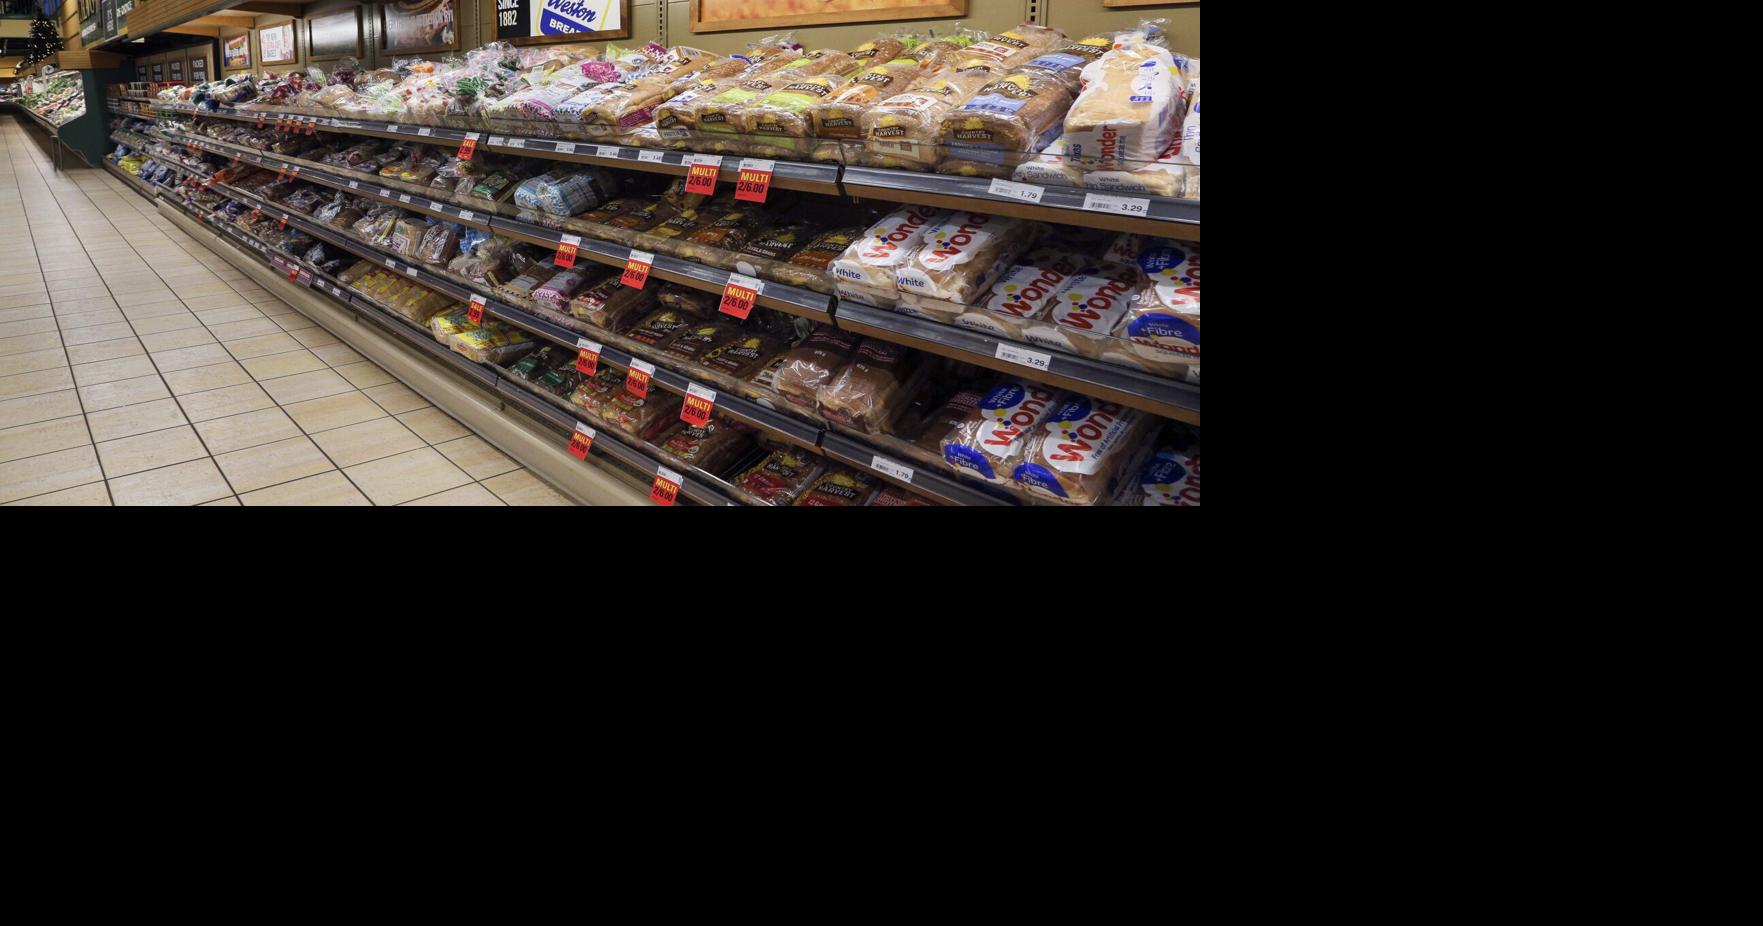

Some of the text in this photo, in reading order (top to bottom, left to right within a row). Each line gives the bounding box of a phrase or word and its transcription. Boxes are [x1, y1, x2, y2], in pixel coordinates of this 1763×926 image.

[498, 0, 519, 10] SINCE
[547, 0, 597, 22] Weston
[499, 10, 517, 27] 1882
[691, 167, 717, 177] MULTI
[740, 171, 769, 183] MULTI
[688, 177, 712, 187] 2/6.00
[738, 182, 764, 193] 2/6.00
[1020, 190, 1038, 199] 1.79
[1121, 203, 1143, 213] 3.29
[559, 244, 577, 254] MULTI
[627, 261, 649, 273] MULTI
[624, 270, 645, 281] 2/6.00
[836, 268, 861, 280] White
[897, 276, 925, 288] White
[727, 286, 755, 301] MULTI
[723, 295, 749, 310] 2/6.00
[580, 350, 598, 362] MULTI
[1027, 357, 1045, 367] 3.29
[629, 370, 648, 383] MULTI
[687, 396, 712, 411] MULTI
[684, 405, 706, 419] 2/6.00
[573, 432, 592, 446] MULTI
[896, 469, 909, 479] 1.79
[656, 478, 678, 493] MULTI
[652, 488, 674, 502] 2/6.00
